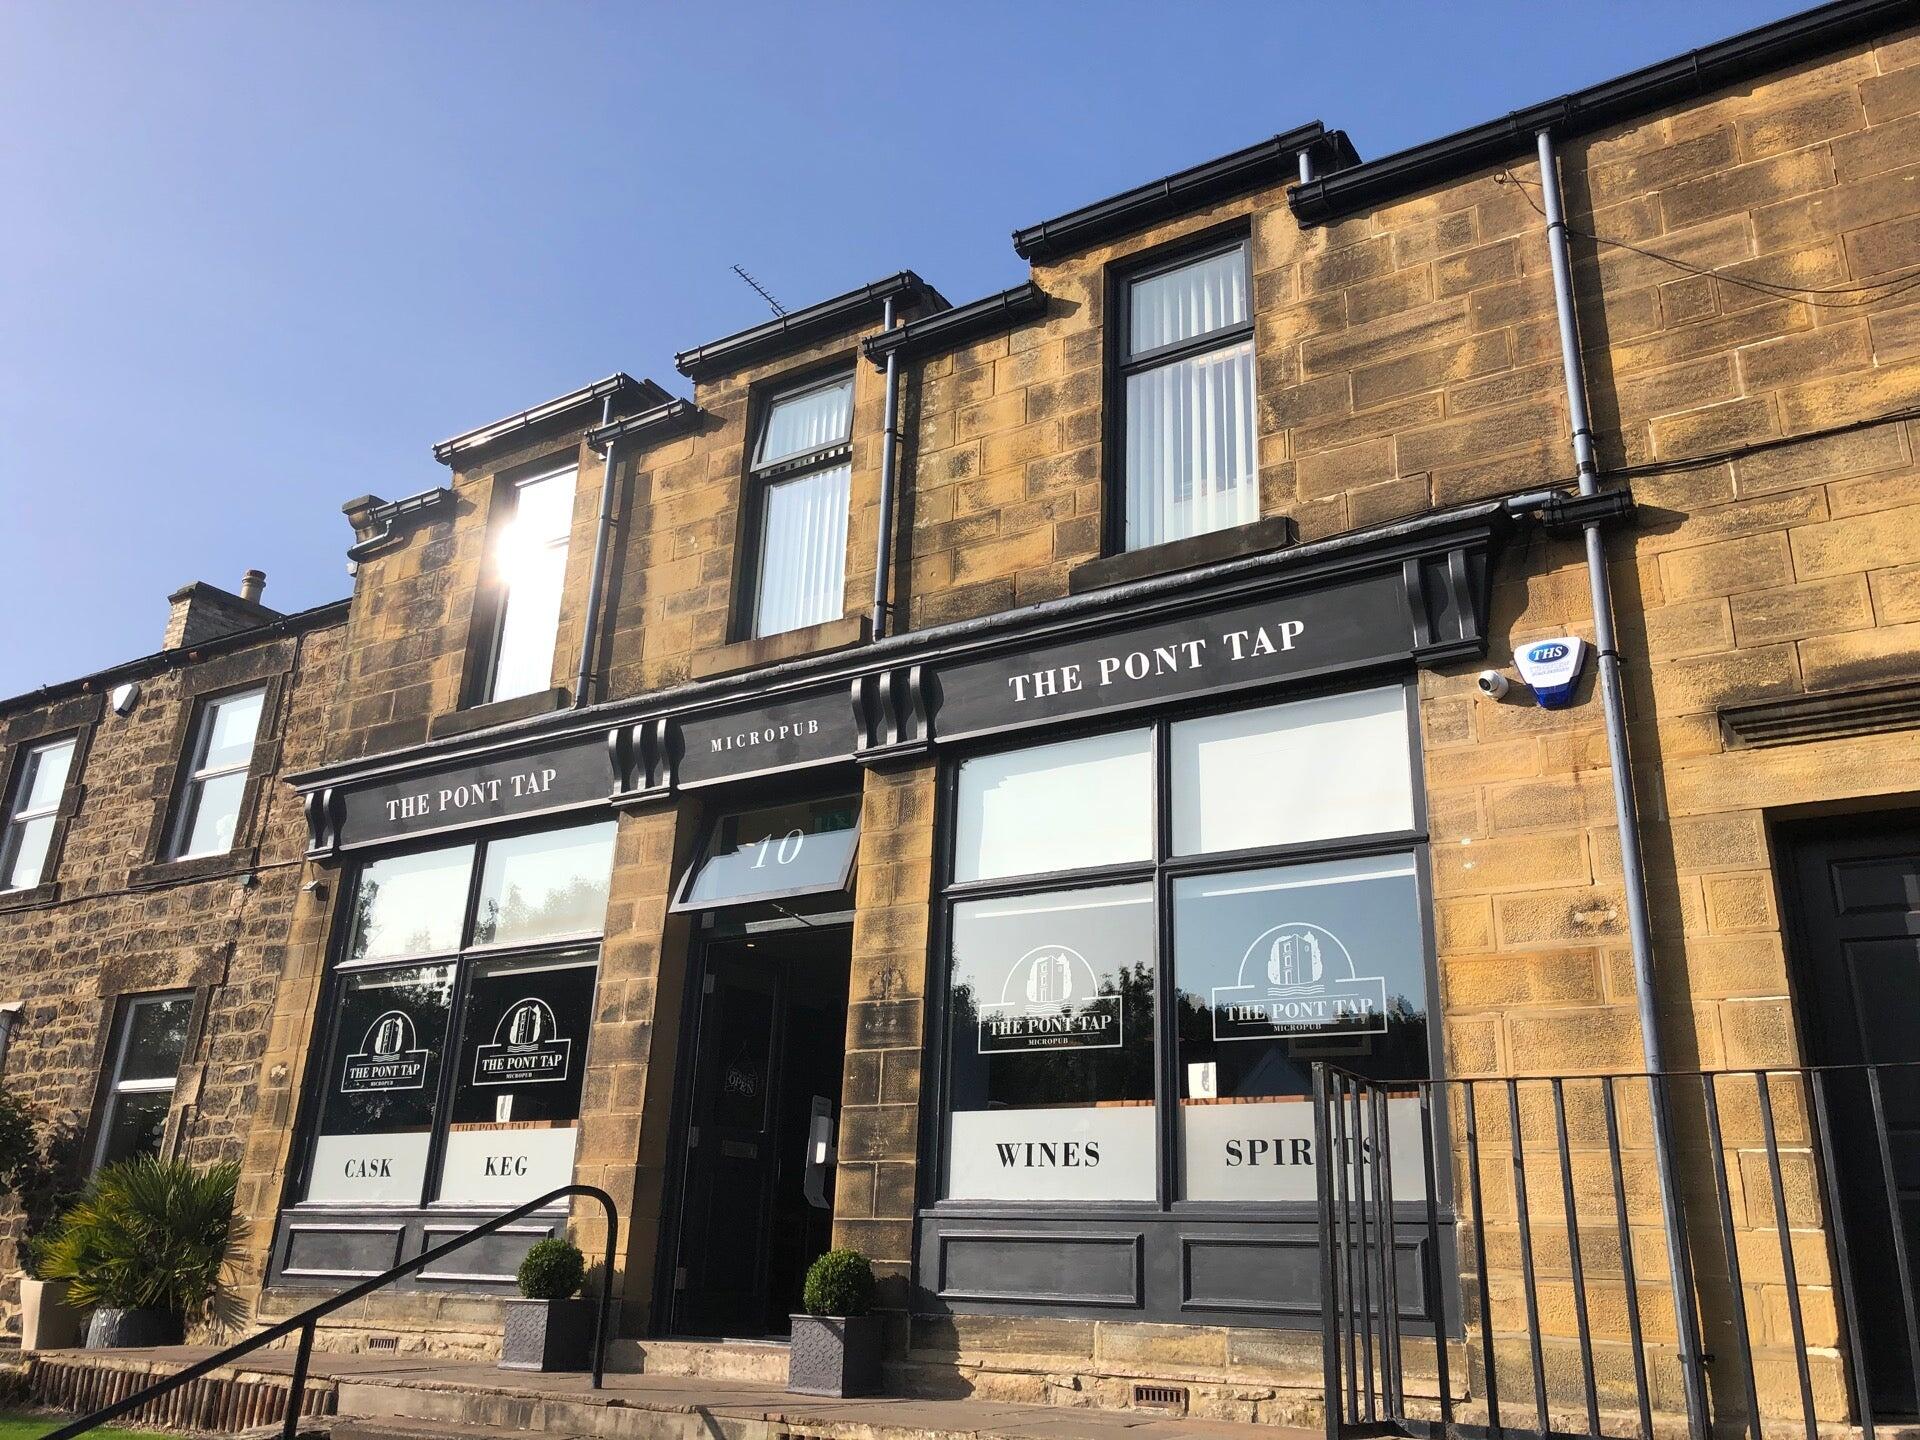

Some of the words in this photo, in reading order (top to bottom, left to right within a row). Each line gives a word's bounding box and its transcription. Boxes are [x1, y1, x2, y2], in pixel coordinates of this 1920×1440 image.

[1008, 664, 1082, 702] THE
[1097, 639, 1206, 686] PONT
[1223, 620, 1304, 661] TAP
[1532, 646, 1563, 660] THS
[710, 719, 819, 752] MICROPUB
[386, 794, 430, 820] THE
[439, 779, 501, 812] PONT
[510, 769, 557, 797] TAP
[750, 828, 804, 869] 10
[1225, 1004, 1265, 1021] THE
[1272, 1001, 1327, 1018] PONT
[1333, 998, 1373, 1016] TAP
[988, 1020, 1022, 1036] THE
[1027, 1017, 1073, 1033] PONT
[1078, 1015, 1112, 1031] TAP
[1273, 1023, 1322, 1032] MICROPUB
[1028, 1037, 1068, 1046] MICROPUB
[349, 1067, 370, 1079] THE
[371, 1065, 399, 1078] PONT
[400, 1064, 420, 1076] TAP
[482, 1058, 504, 1071] THE
[507, 1056, 537, 1069] PONT
[540, 1054, 562, 1067] TAP
[728, 1074, 754, 1094] OPEN
[995, 1141, 1100, 1167] WINES
[1226, 1138, 1381, 1166] SPIRTS
[344, 1158, 393, 1178] CASK
[484, 1155, 528, 1177] KEG
